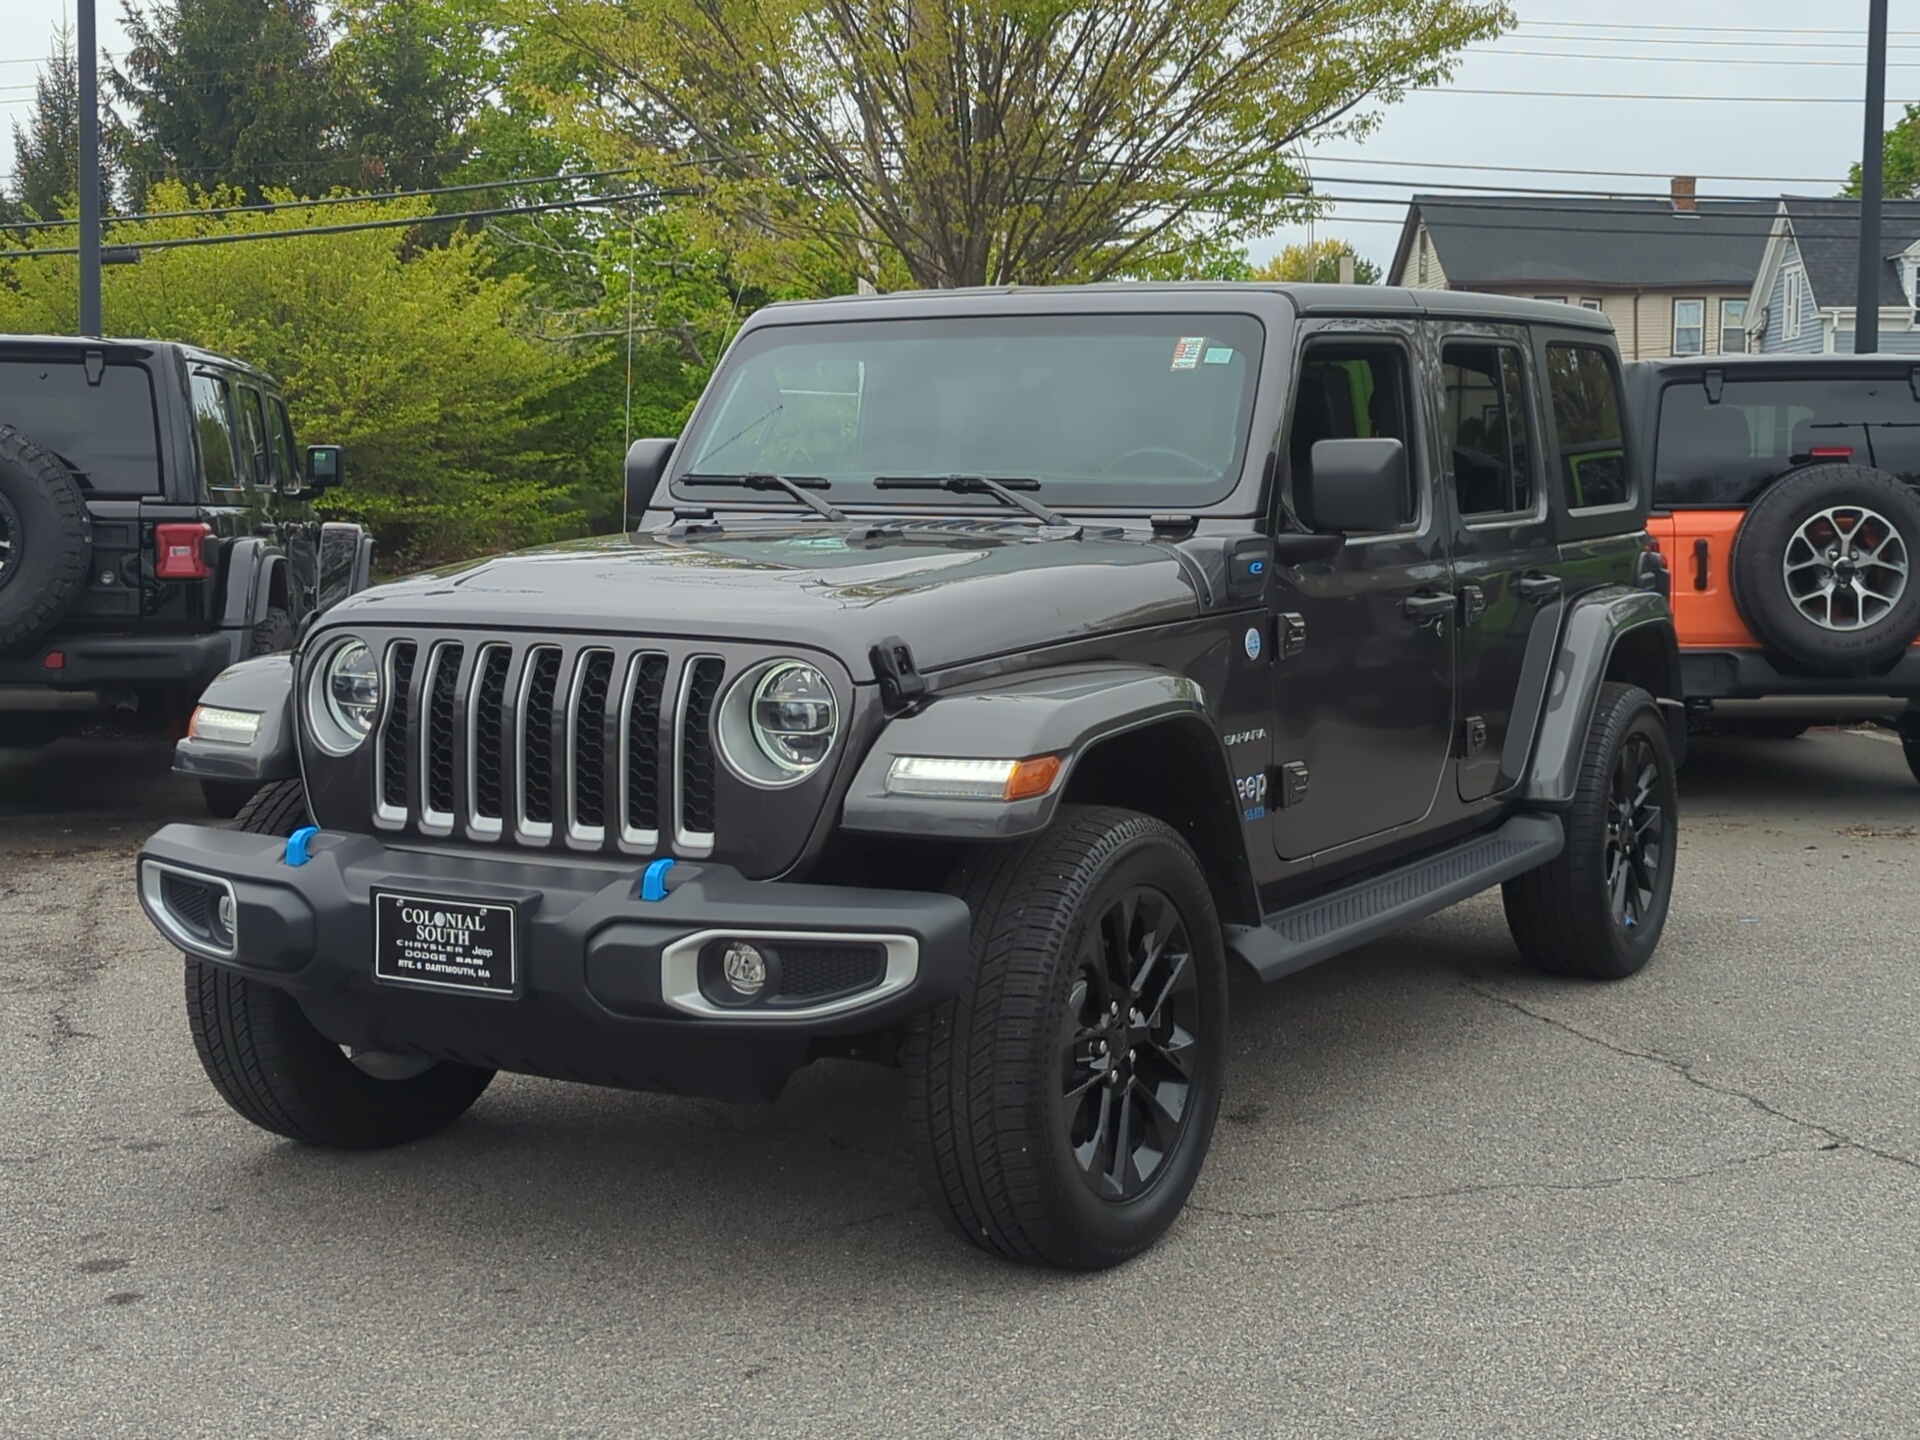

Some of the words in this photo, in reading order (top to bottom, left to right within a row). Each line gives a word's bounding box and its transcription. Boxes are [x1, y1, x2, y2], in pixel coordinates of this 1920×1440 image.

[1223, 728, 1267, 746] SAHARA
[1235, 773, 1267, 802] eep
[401, 907, 486, 931] COLONIAL
[416, 925, 470, 946] SOUTH
[396, 939, 464, 954] CHRYSLER
[471, 945, 493, 958] Jeep
[404, 949, 447, 962] DODGE
[455, 956, 484, 966] RAM
[398, 959, 415, 969] RTE.
[425, 962, 476, 978] DARTMOUTH,
[477, 969, 491, 978] MA
